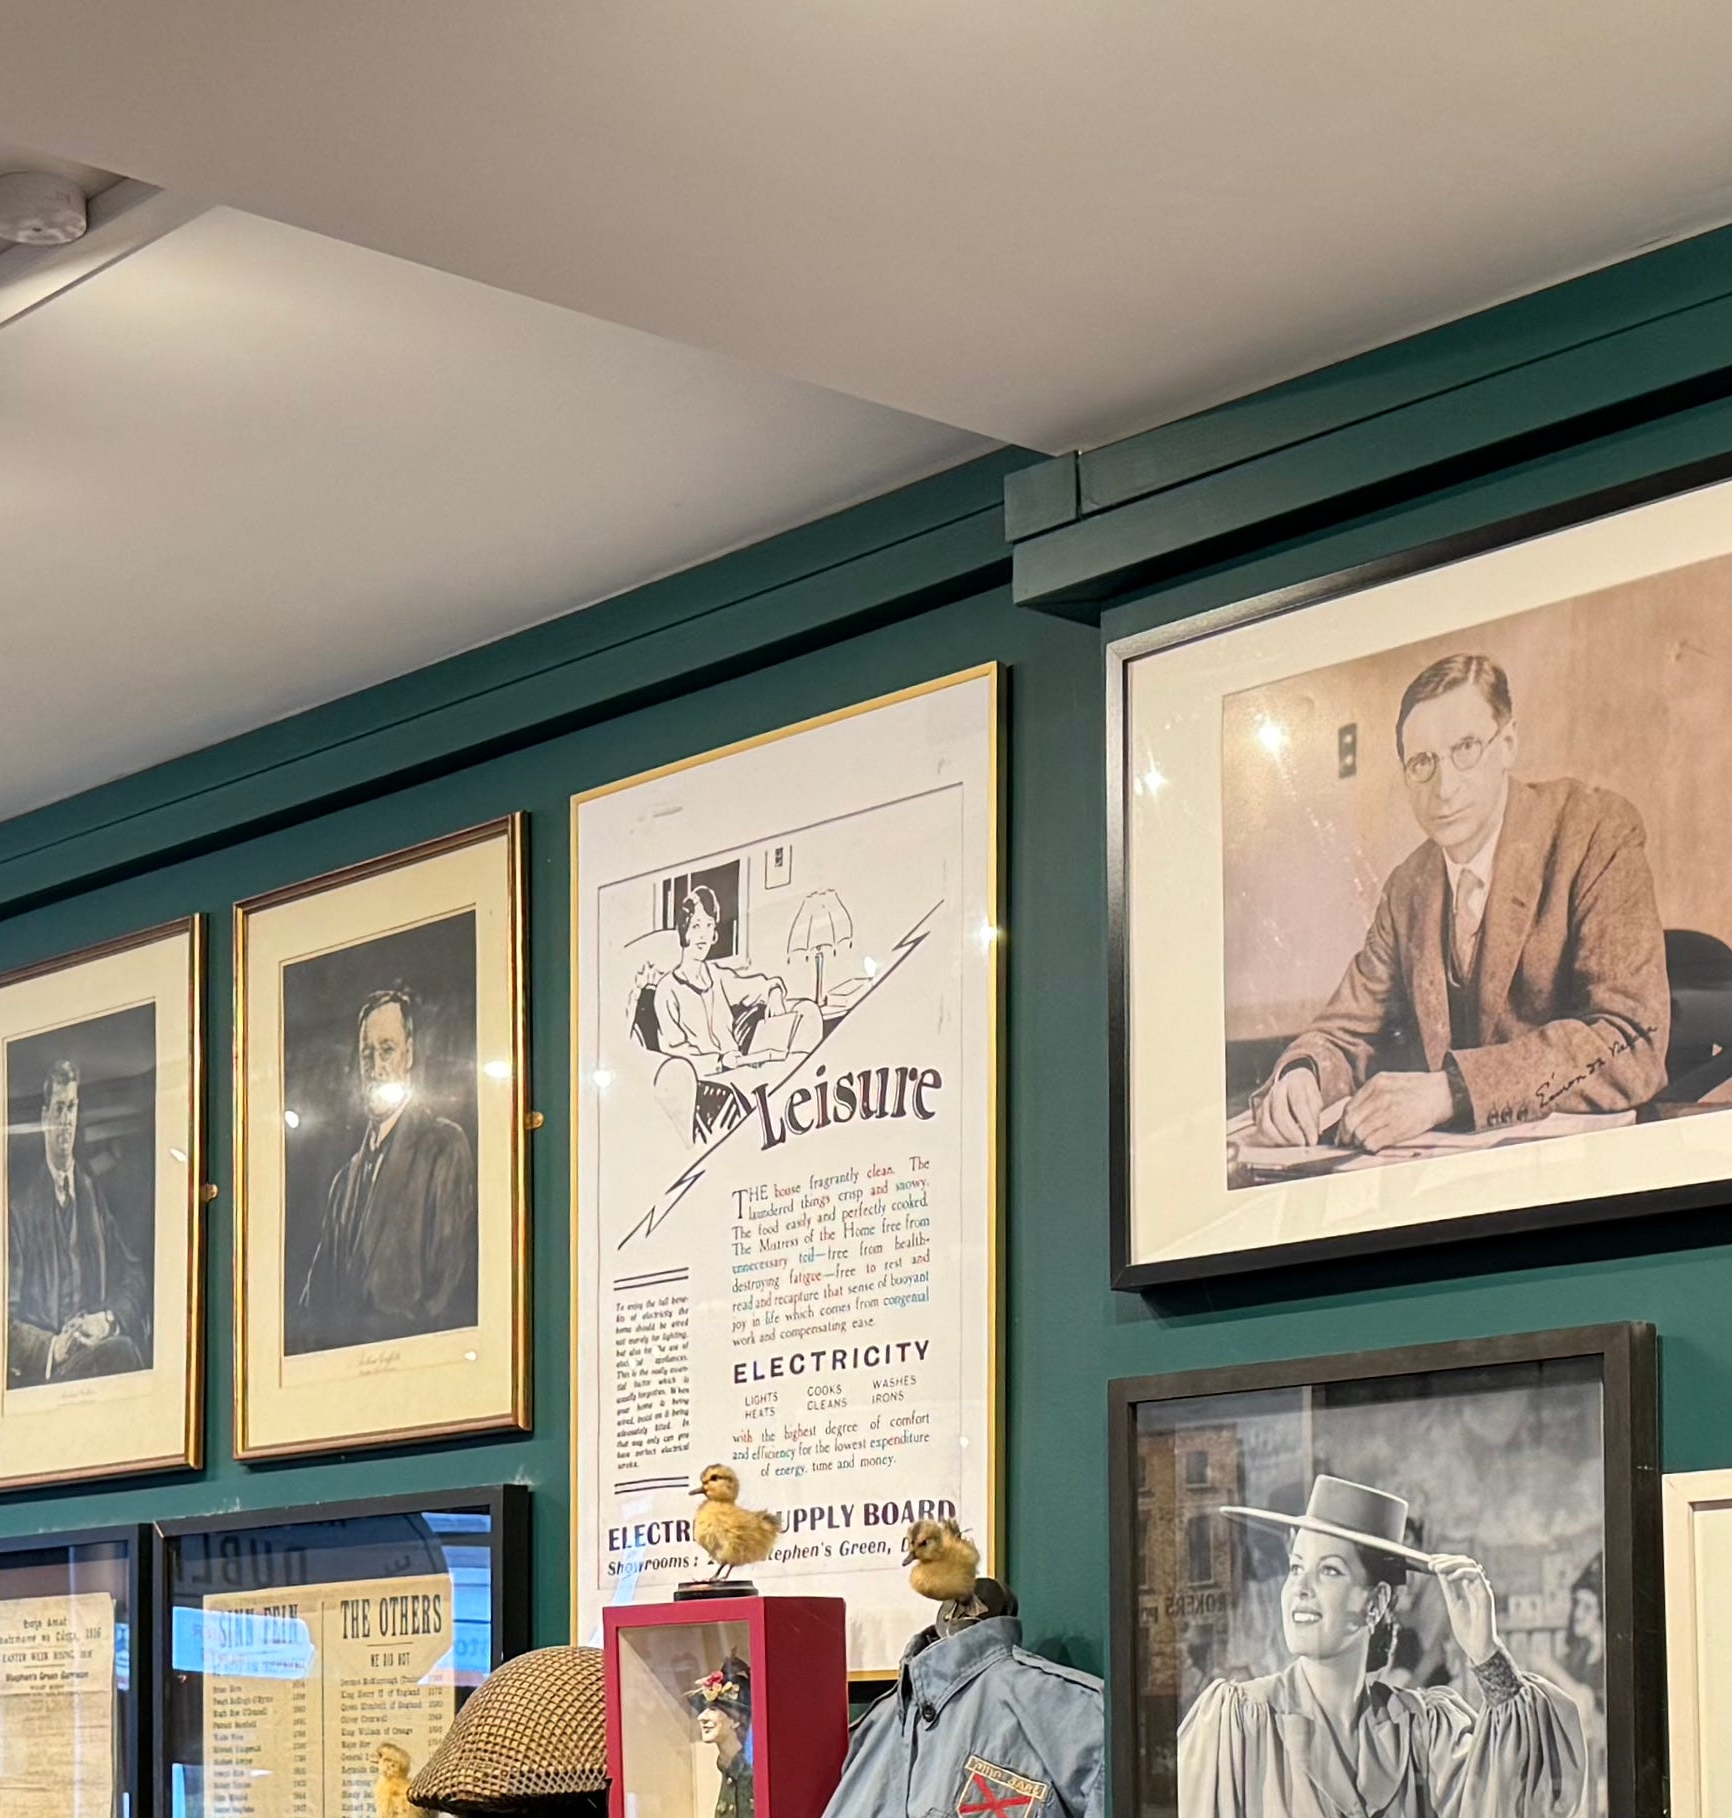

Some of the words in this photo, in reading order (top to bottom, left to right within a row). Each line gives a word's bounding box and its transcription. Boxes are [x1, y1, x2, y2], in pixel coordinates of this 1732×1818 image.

[751, 1064, 942, 1150] Leisure
[734, 1340, 929, 1384] ELECTRICITY
[745, 1392, 778, 1407] LIGHTS
[807, 1384, 842, 1397] COOKS
[873, 1375, 917, 1390] WASHES
[745, 1408, 776, 1420] HEATS
[807, 1398, 847, 1411] CLEANS
[872, 1391, 904, 1405] IRONS
[608, 1520, 696, 1551] ELECTR
[839, 1540, 891, 1557] Green,
[340, 1599, 371, 1640] THE
[379, 1594, 442, 1636] OTHERS
[370, 1653, 380, 1668] WE
